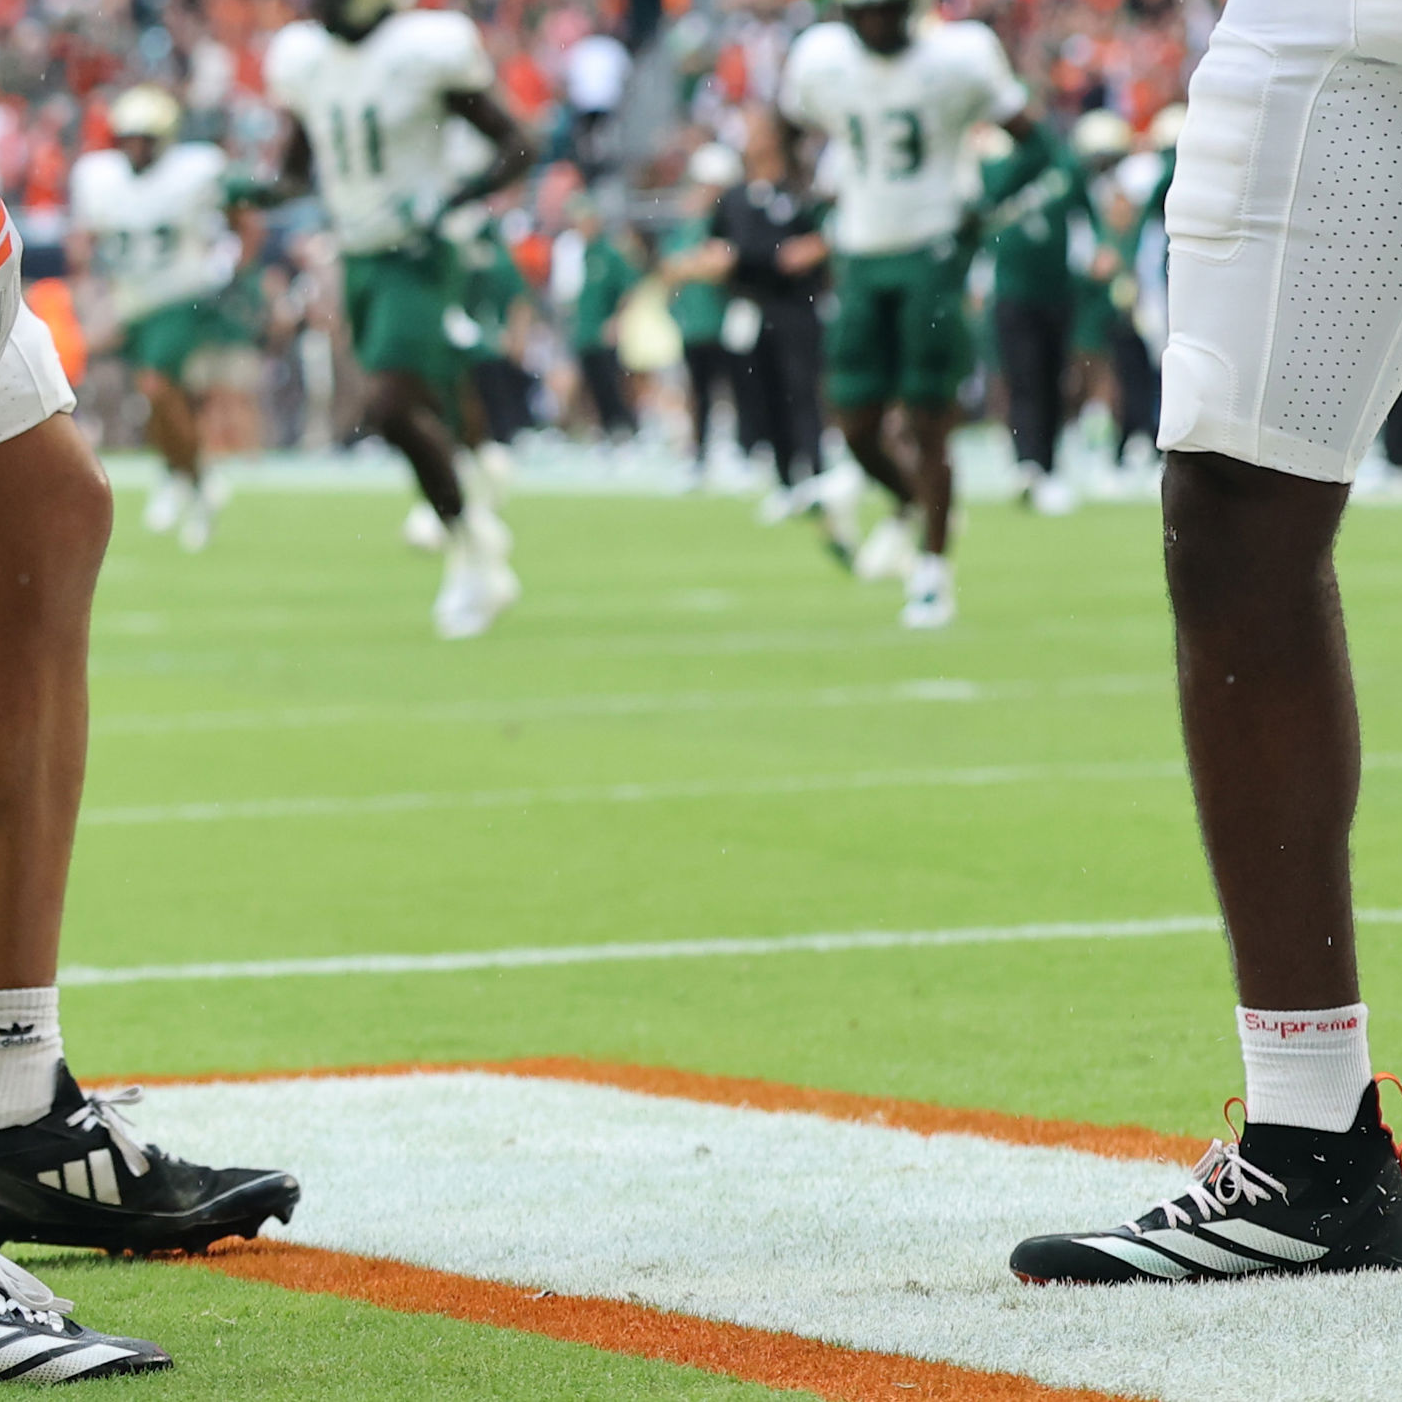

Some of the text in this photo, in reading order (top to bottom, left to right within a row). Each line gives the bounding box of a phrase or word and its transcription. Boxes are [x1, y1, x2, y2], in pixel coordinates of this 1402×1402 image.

[329, 101, 385, 176] 11
[847, 108, 924, 180] 13
[1244, 1012, 1358, 1039] Supreme
